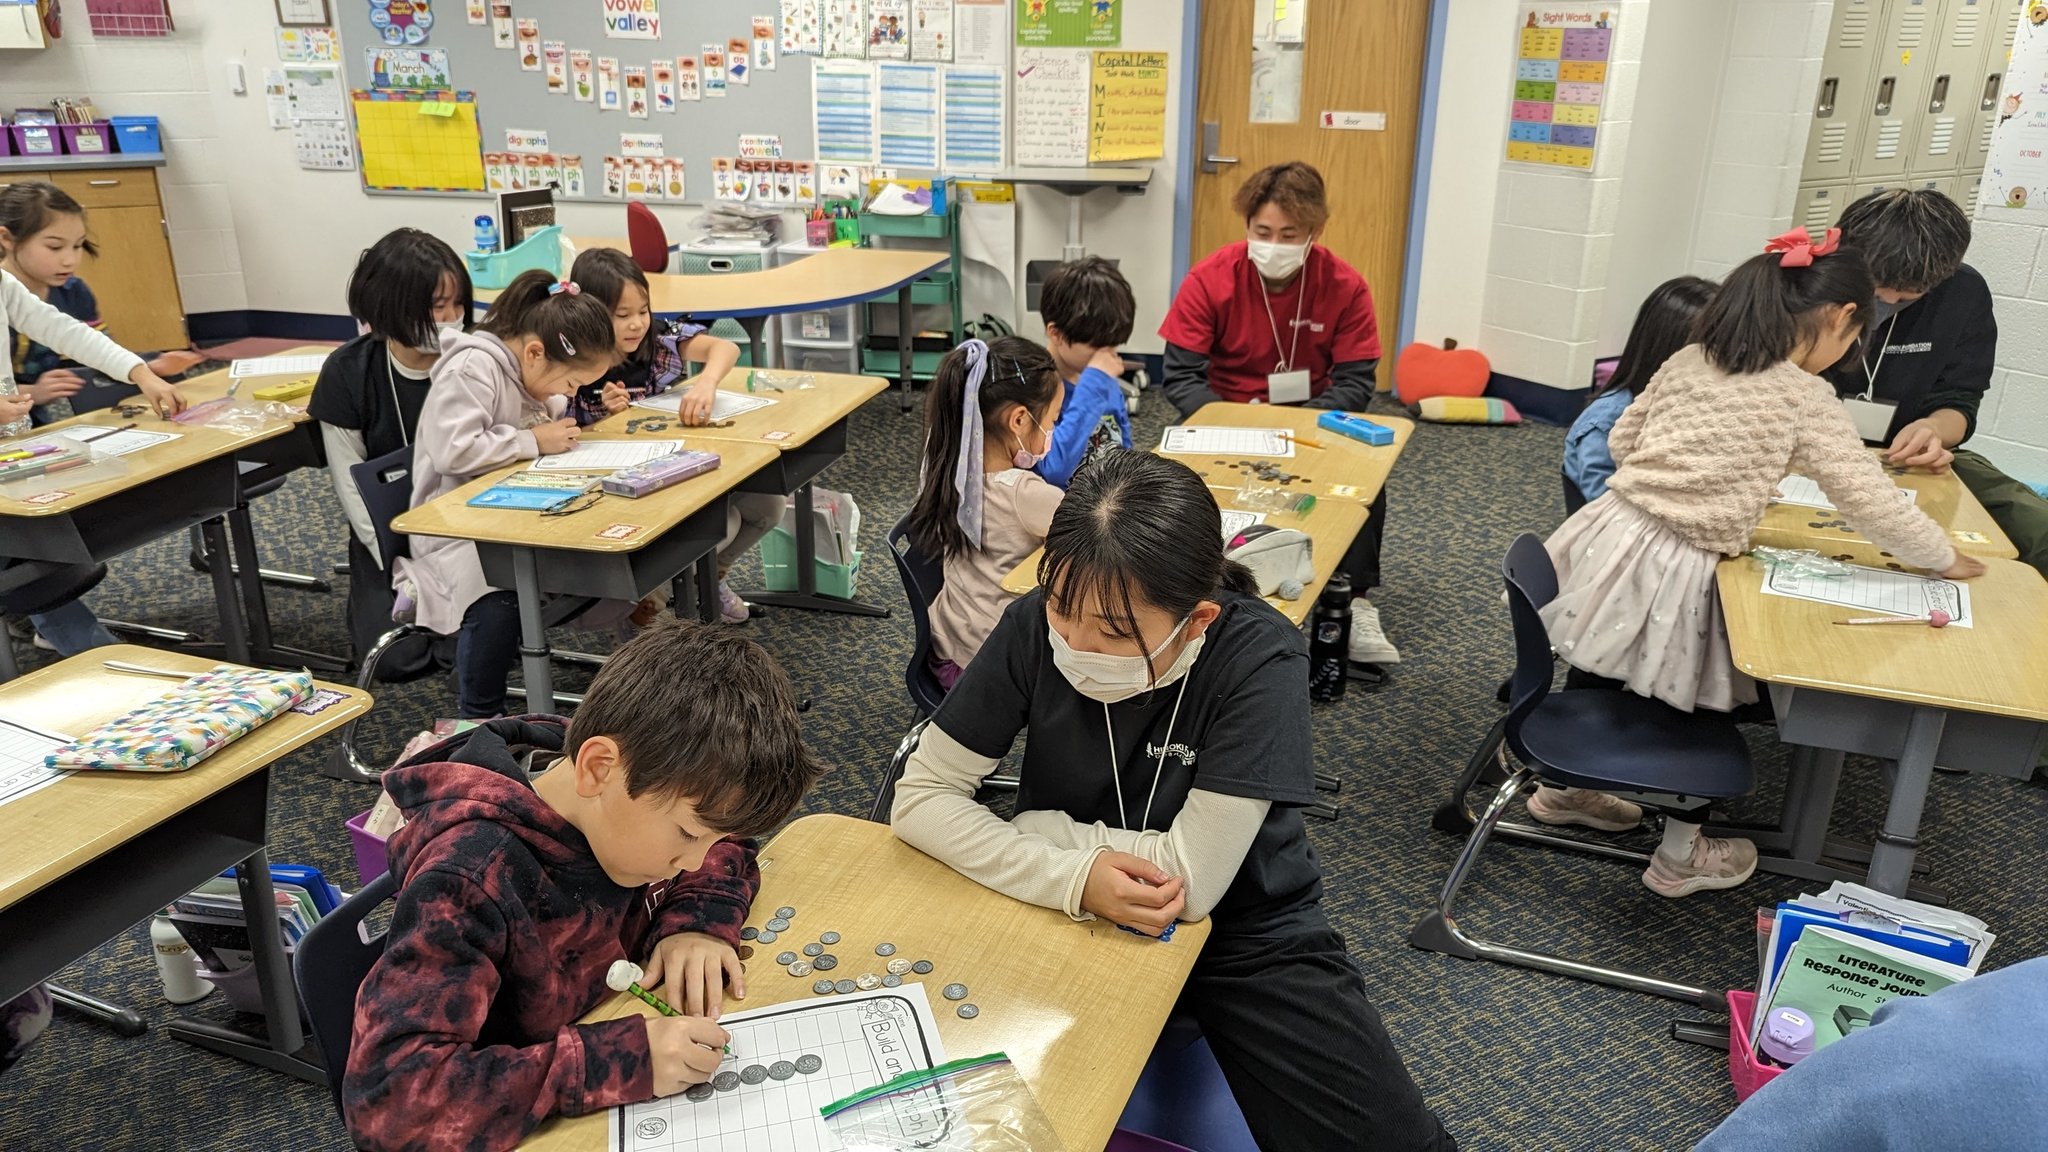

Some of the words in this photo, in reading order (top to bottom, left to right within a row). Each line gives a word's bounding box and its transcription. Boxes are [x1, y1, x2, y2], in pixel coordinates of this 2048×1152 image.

[605, 0, 658, 12] vowel
[1543, 12, 1563, 24] Sight
[1566, 12, 1592, 23] Words
[606, 14, 658, 35] valley
[1021, 50, 1070, 66] Sentence
[1098, 52, 1132, 70] Capital
[1136, 53, 1164, 67] Letters
[393, 62, 425, 74] March
[1034, 66, 1080, 80] Checklist
[1344, 116, 1361, 126] door
[742, 146, 780, 156] vowels
[2020, 150, 2041, 158] OCTOBER
[490, 167, 502, 176] ch
[529, 169, 540, 177] sh
[545, 168, 560, 177] wh
[567, 170, 580, 182] ph
[1843, 900, 1869, 911] Valenti
[1827, 983, 1867, 999] Author
[1879, 982, 1928, 997] JOUR
[871, 1021, 900, 1054] Build
